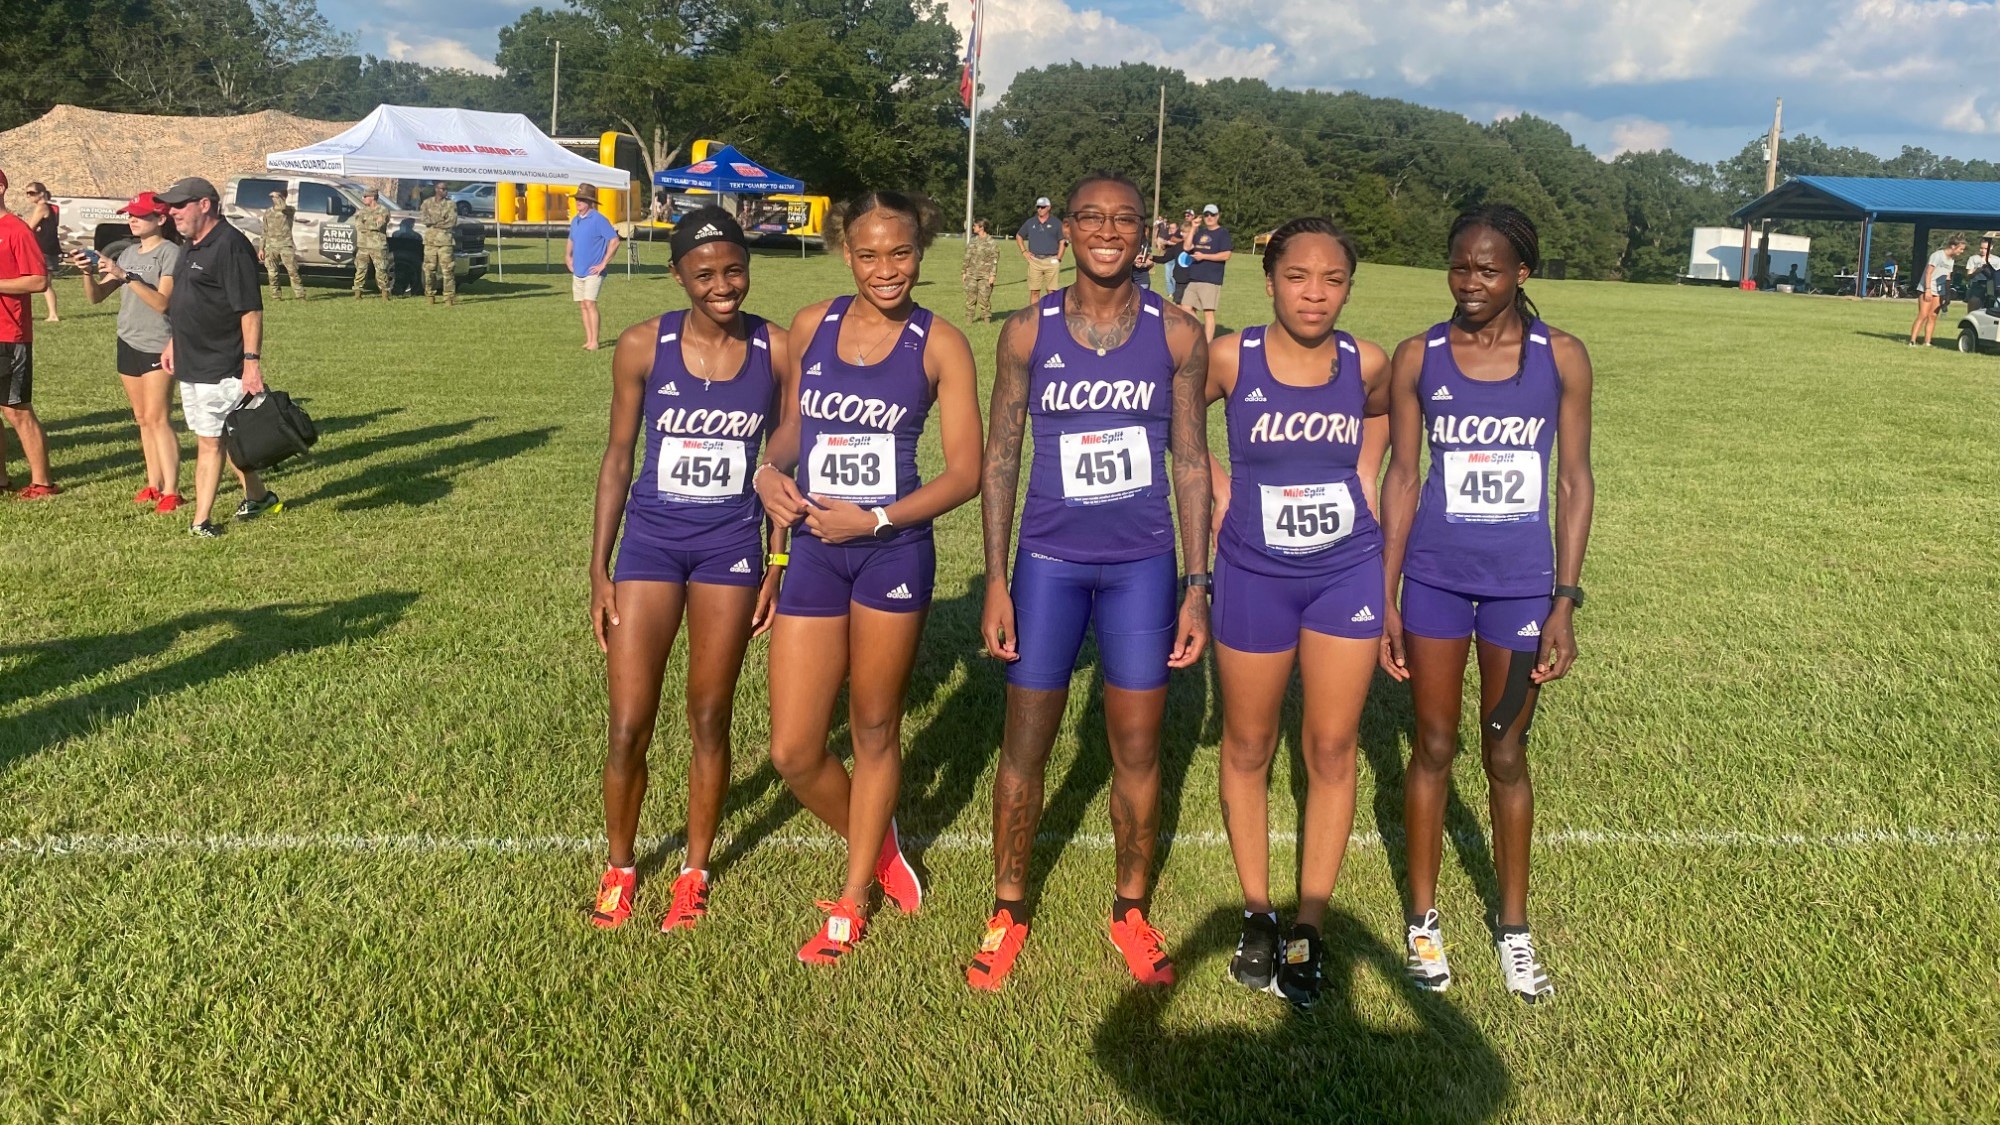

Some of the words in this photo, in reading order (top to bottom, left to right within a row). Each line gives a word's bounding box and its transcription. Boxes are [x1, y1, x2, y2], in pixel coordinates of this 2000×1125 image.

[416, 142, 474, 153] NATIONAL
[473, 145, 513, 156] GUARD
[323, 229, 353, 239] ARMY
[694, 230, 724, 240] adidas
[322, 242, 354, 251] GUARD
[657, 389, 680, 397] adidas
[1041, 380, 1156, 411] ALCORN
[800, 389, 907, 432] ALCORN
[656, 407, 765, 438] ALCORN
[1250, 411, 1360, 445] ALCORN
[1431, 415, 1546, 446] ALCORN
[682, 440, 724, 451] MileSplit
[827, 436, 872, 448] MileSplit
[1080, 431, 1124, 446] MileSplit
[1468, 453, 1515, 465] MileSplit
[670, 456, 731, 487] 454
[820, 452, 881, 486] 453
[1075, 448, 1132, 486] 451
[1283, 486, 1326, 499] MileSplit
[1459, 469, 1525, 504] 452
[1276, 502, 1340, 538] 455
[729, 566, 751, 574] adidas
[886, 591, 912, 599] adidas
[1351, 614, 1375, 623] adidas
